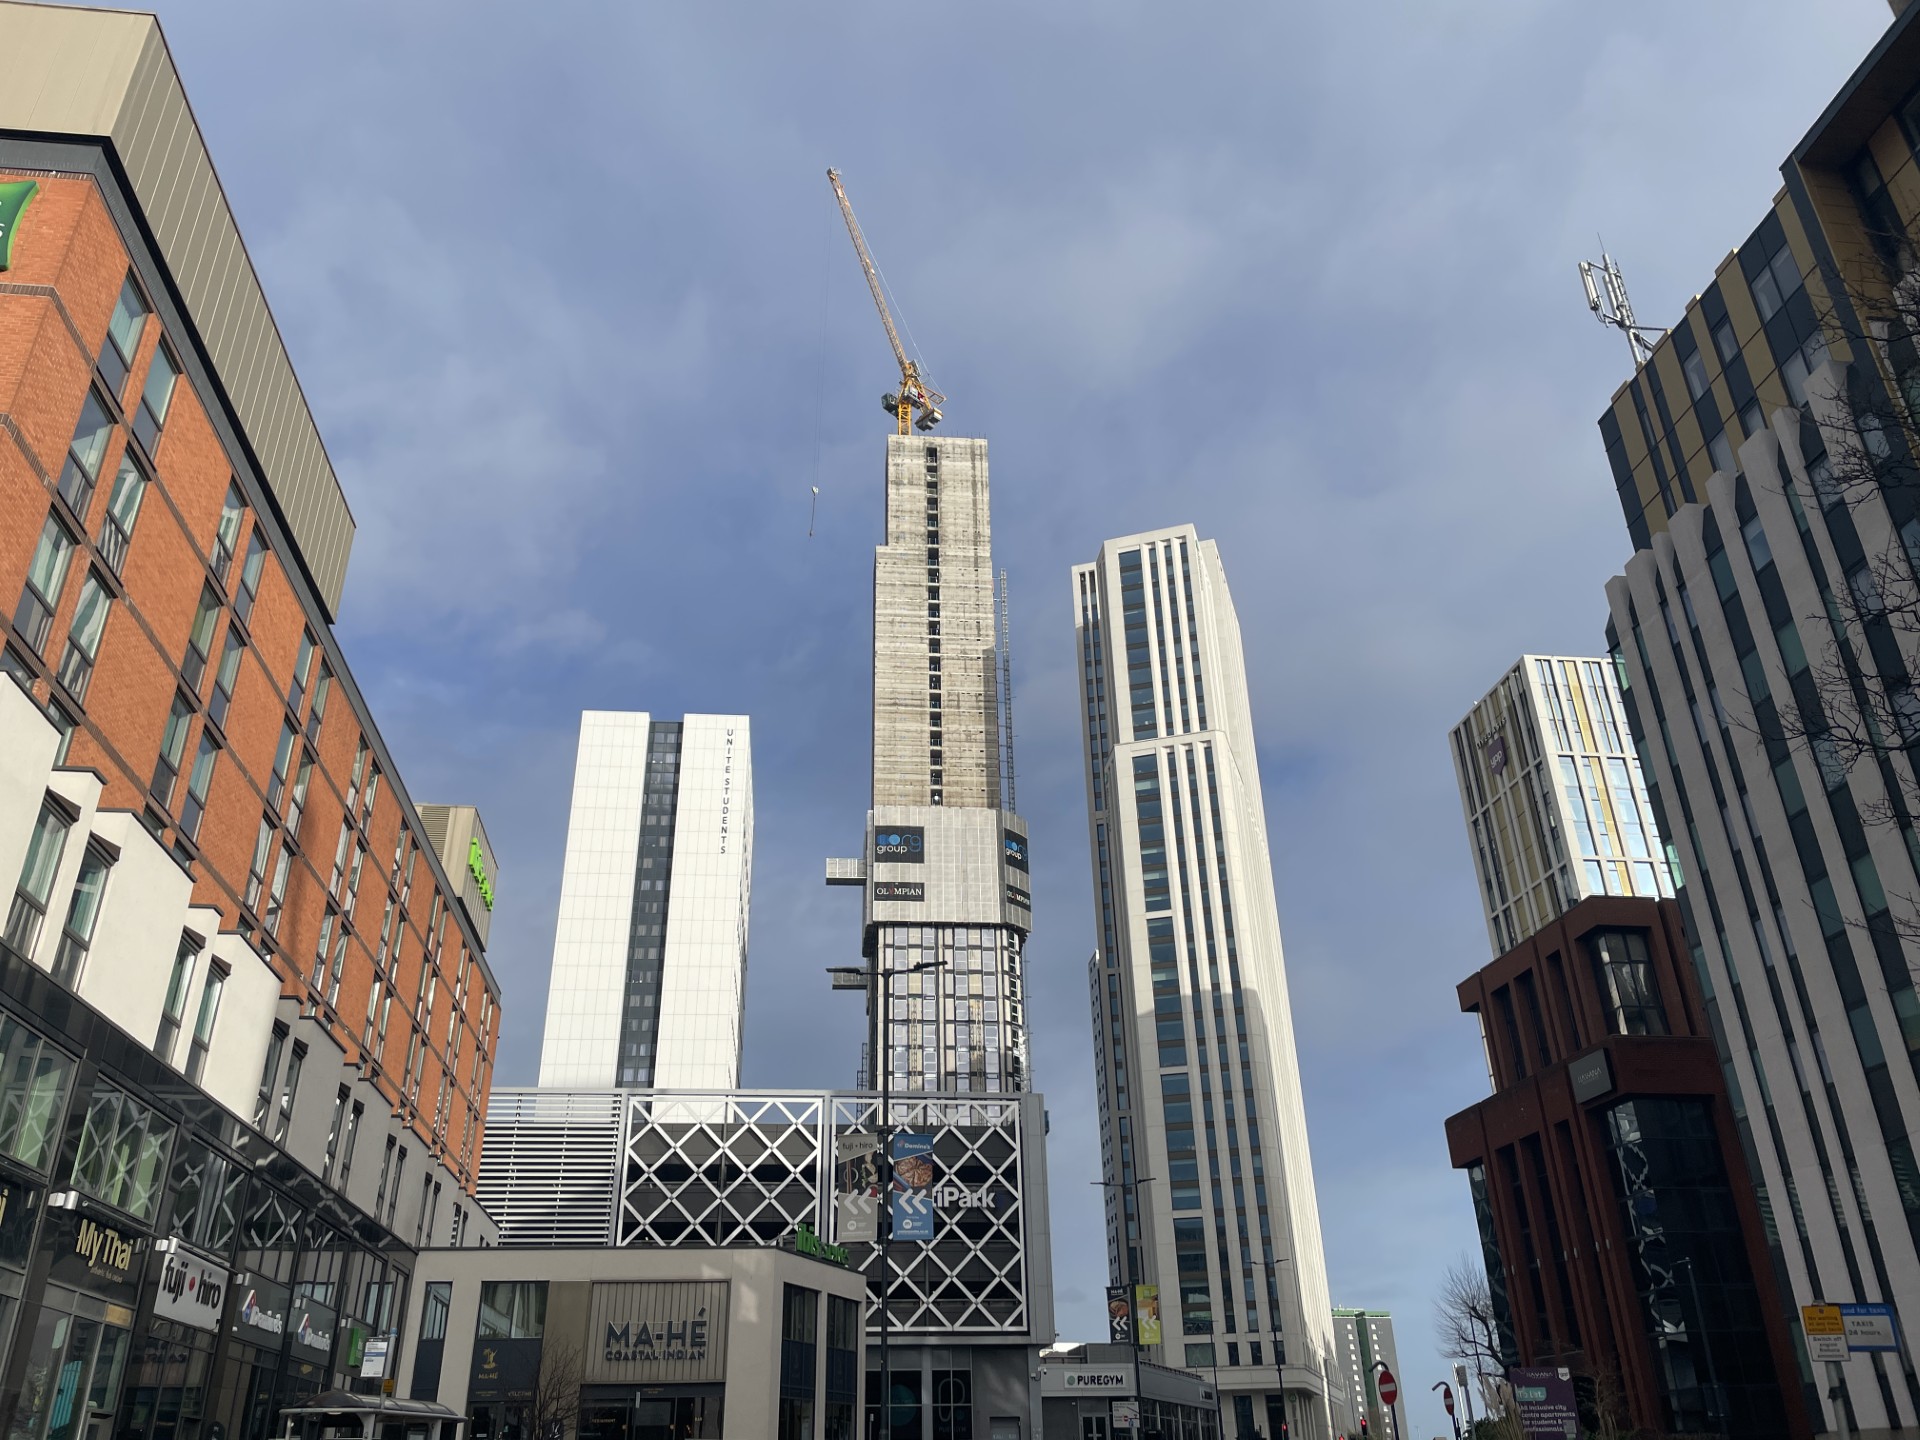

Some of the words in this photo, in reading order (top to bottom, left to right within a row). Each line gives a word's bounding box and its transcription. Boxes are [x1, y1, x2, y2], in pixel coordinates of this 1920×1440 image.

[725, 729, 734, 774] UNITE
[1490, 750, 1503, 769] ypp
[721, 778, 730, 854] STUDENTS
[876, 845, 908, 855] group
[1005, 847, 1022, 861] group
[876, 887, 922, 897] OLYMPIAN
[842, 1142, 854, 1152] fuji
[859, 1141, 873, 1150] hiro
[904, 1142, 931, 1151] Domino's
[76, 1218, 104, 1268] My
[103, 1228, 134, 1271] Thai
[162, 1256, 189, 1305] fuji
[196, 1268, 222, 1309] hiro
[606, 1306, 708, 1348] MA-HÉ
[605, 1350, 659, 1362] COASTAL
[662, 1350, 707, 1361] INDIAN
[1077, 1374, 1124, 1386] PUREGYM
[1555, 1403, 1567, 1411] city
